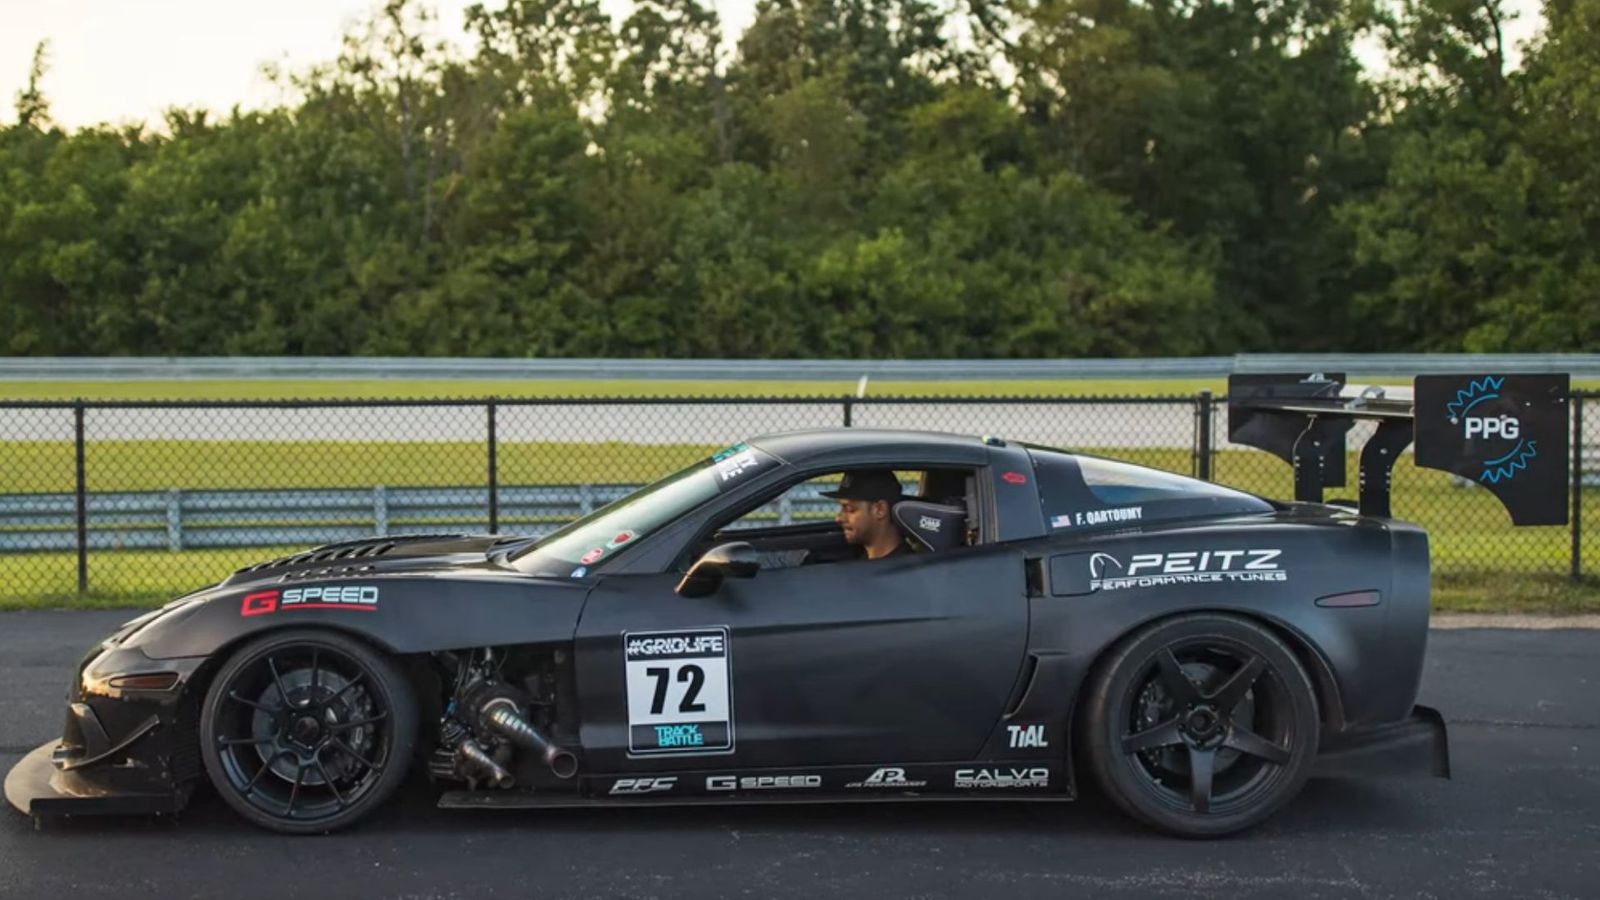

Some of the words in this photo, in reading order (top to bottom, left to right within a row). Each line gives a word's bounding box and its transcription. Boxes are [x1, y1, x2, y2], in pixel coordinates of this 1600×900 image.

[1465, 417, 1519, 439] PPG
[1076, 512, 1086, 526] F.
[1086, 507, 1142, 525] QARTOUMY
[1128, 549, 1282, 576] PEITZ
[1090, 573, 1223, 591] PERFORMANCE
[1225, 571, 1287, 582] TUNES
[627, 636, 724, 655] #GRIDLIFE
[646, 664, 706, 715] 72
[654, 724, 698, 738] TRACK
[658, 733, 704, 747] BATTLE
[955, 768, 1049, 780] CALVO
